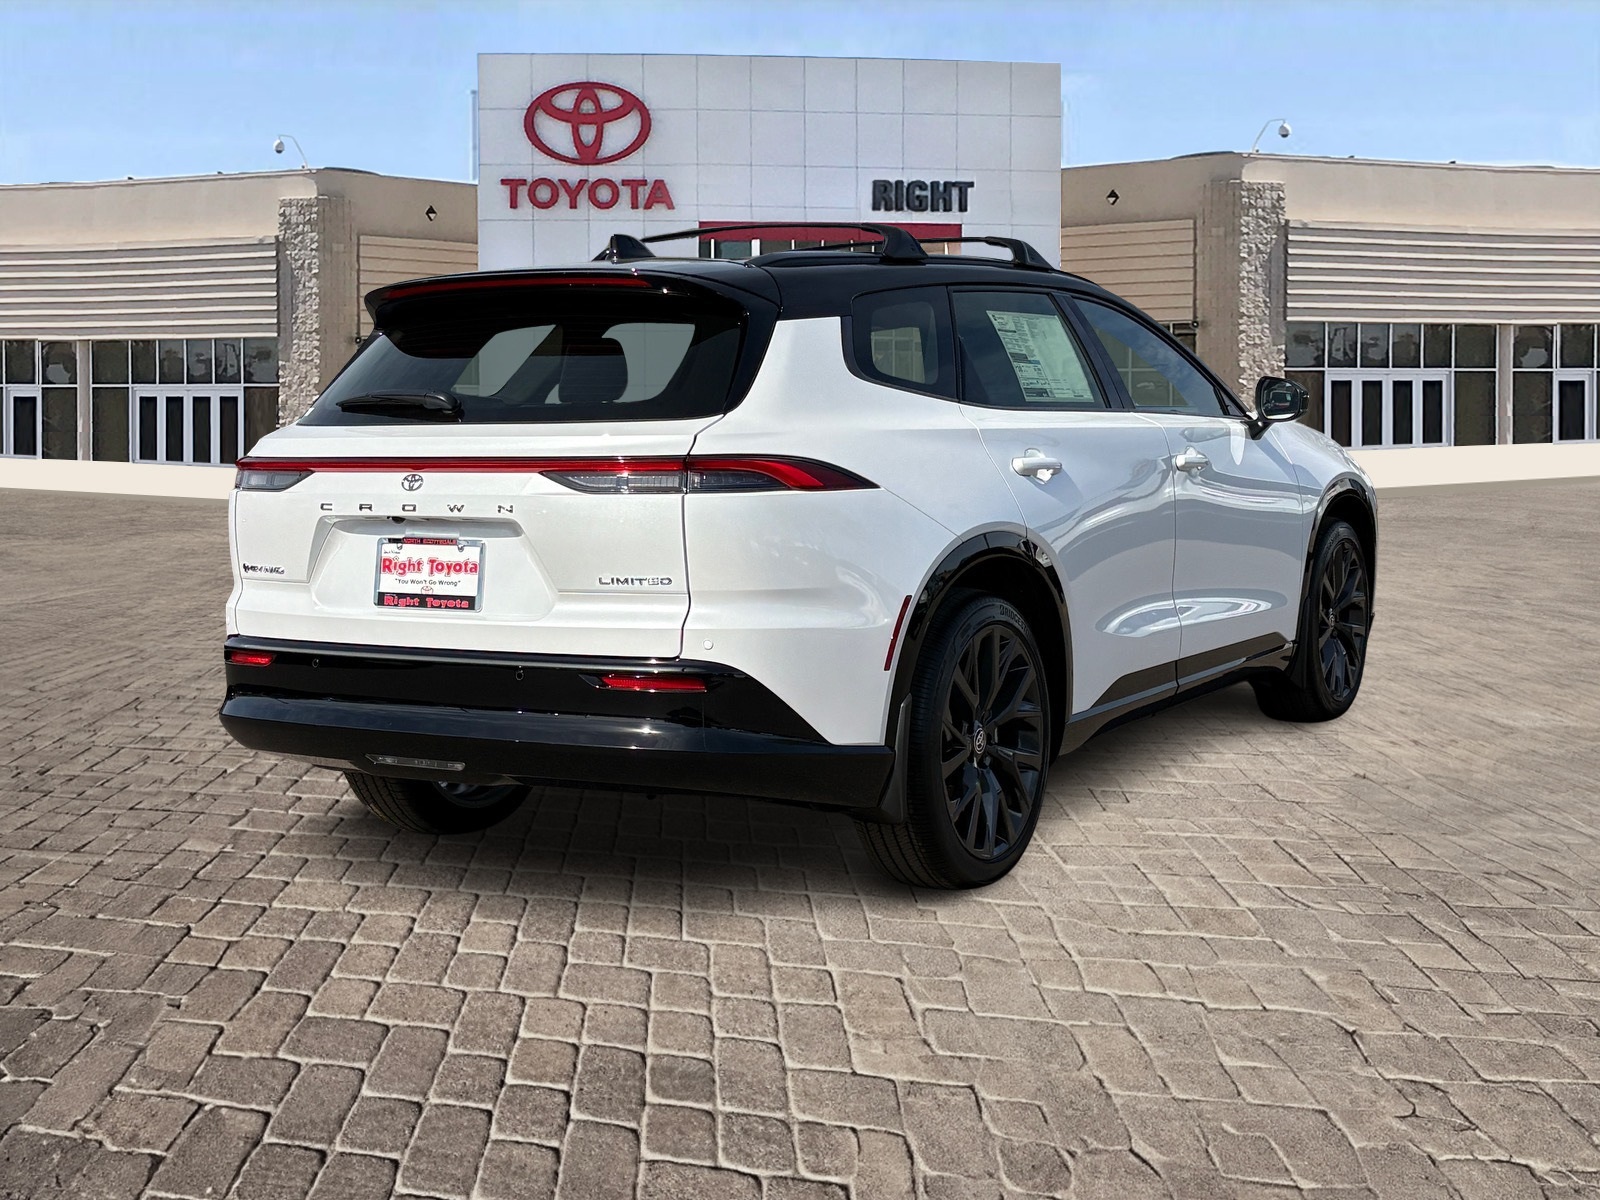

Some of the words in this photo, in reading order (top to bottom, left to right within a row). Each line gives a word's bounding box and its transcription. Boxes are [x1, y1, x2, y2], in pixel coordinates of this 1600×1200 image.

[500, 178, 675, 210] TOYOTA
[872, 180, 975, 212] RIGHT
[320, 502, 514, 514] CROWN
[382, 557, 424, 575] Right
[428, 558, 478, 576] Toyota
[598, 577, 673, 586] LIMITED
[383, 595, 420, 607] Right
[426, 597, 469, 608] Toyota
